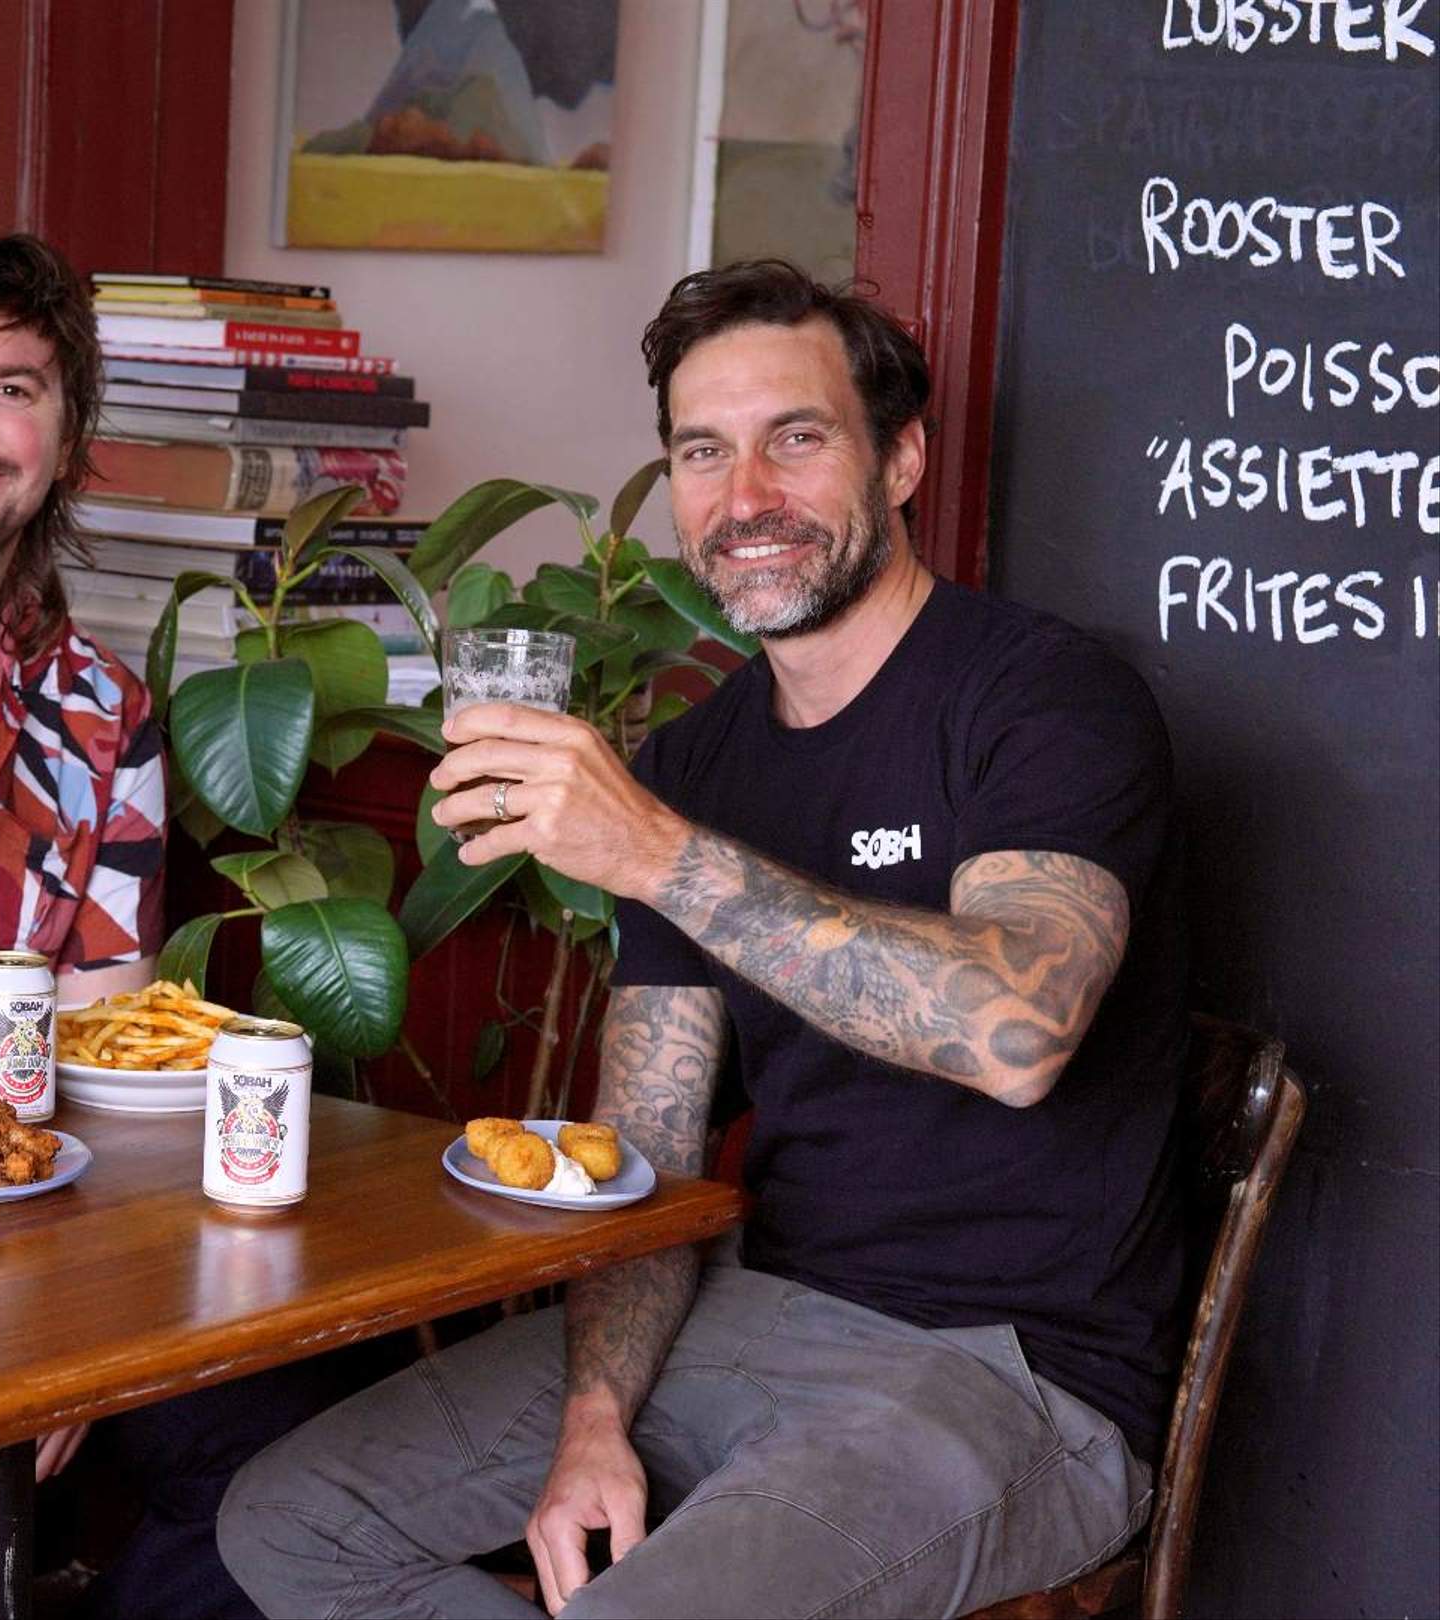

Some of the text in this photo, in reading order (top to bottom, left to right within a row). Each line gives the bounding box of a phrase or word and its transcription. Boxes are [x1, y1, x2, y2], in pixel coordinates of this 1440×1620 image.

[1162, 0, 1436, 61] LOBSTER
[1141, 176, 1406, 280] ROOSTER
[1158, 555, 1385, 644] FRITES
[9, 1001, 44, 1013] SOBAH
[233, 1074, 272, 1088] SOBAH
